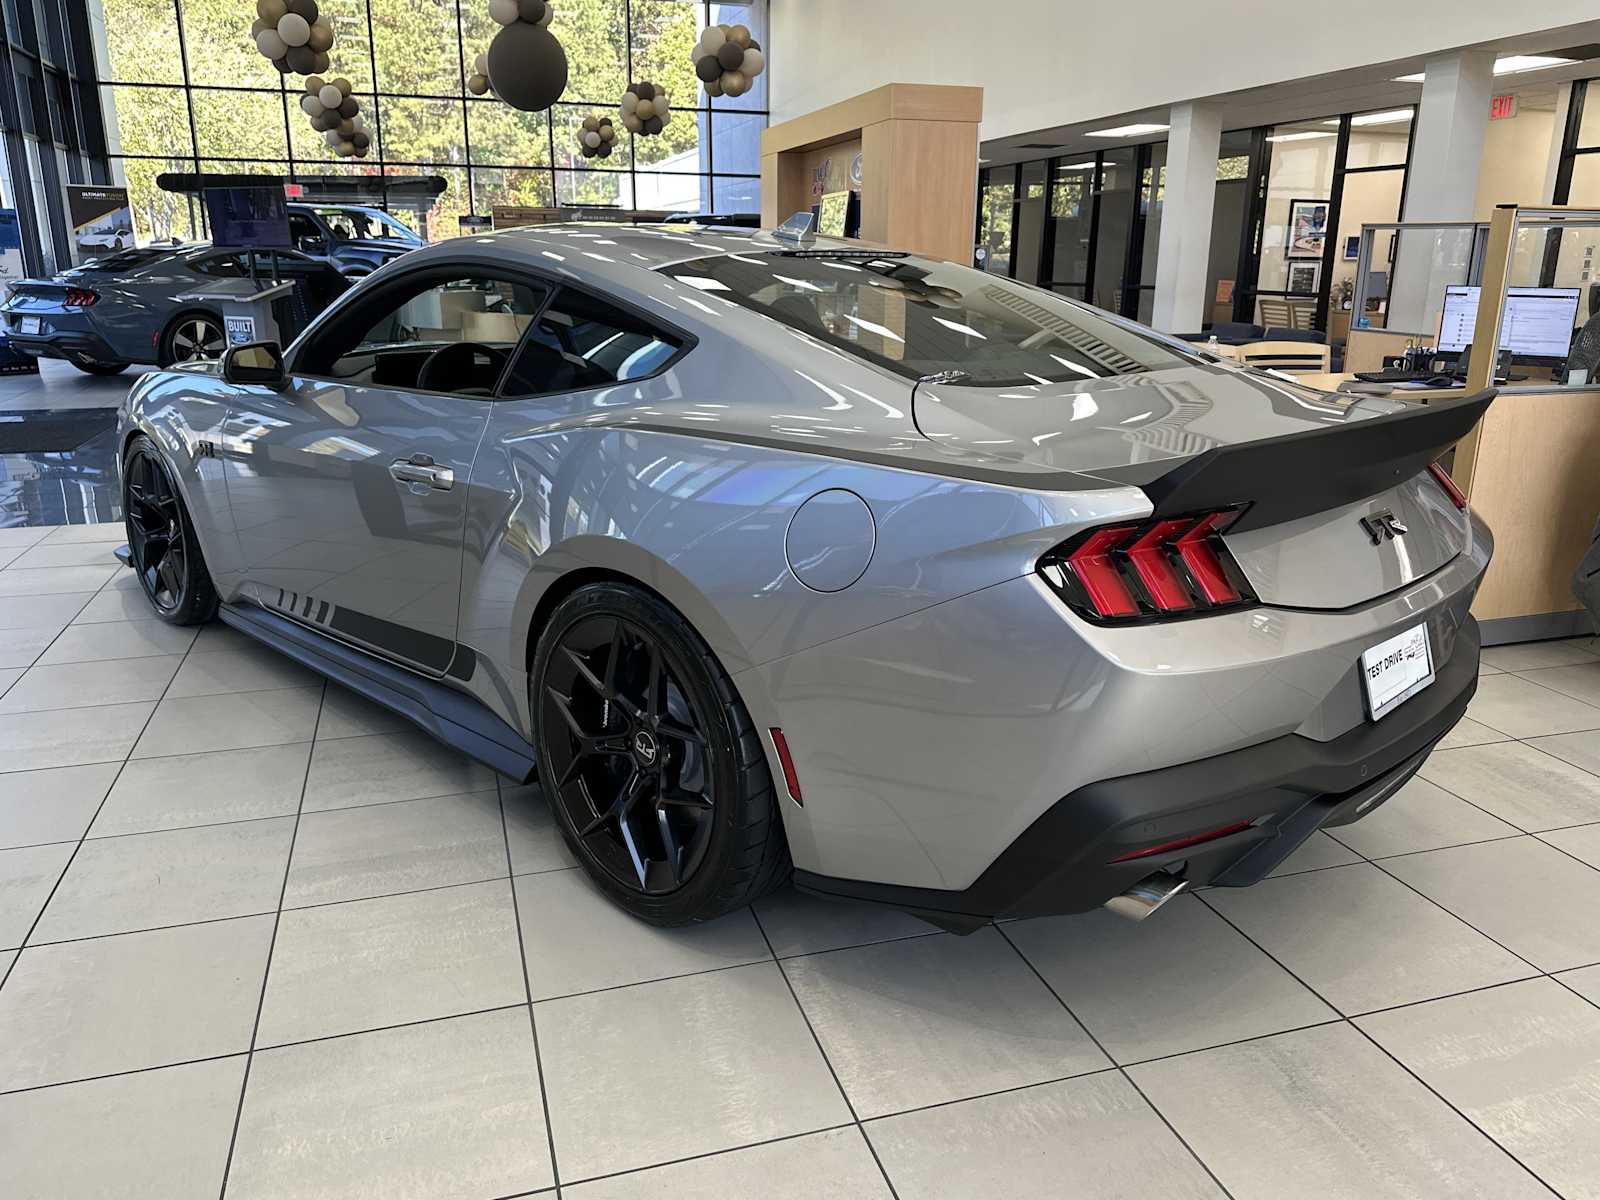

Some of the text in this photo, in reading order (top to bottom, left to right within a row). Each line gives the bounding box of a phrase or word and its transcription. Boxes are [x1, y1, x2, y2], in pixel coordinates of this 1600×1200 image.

[1491, 95, 1514, 119] EXIT
[227, 320, 252, 333] BUILT
[1366, 649, 1404, 681] TEST DRIVE
